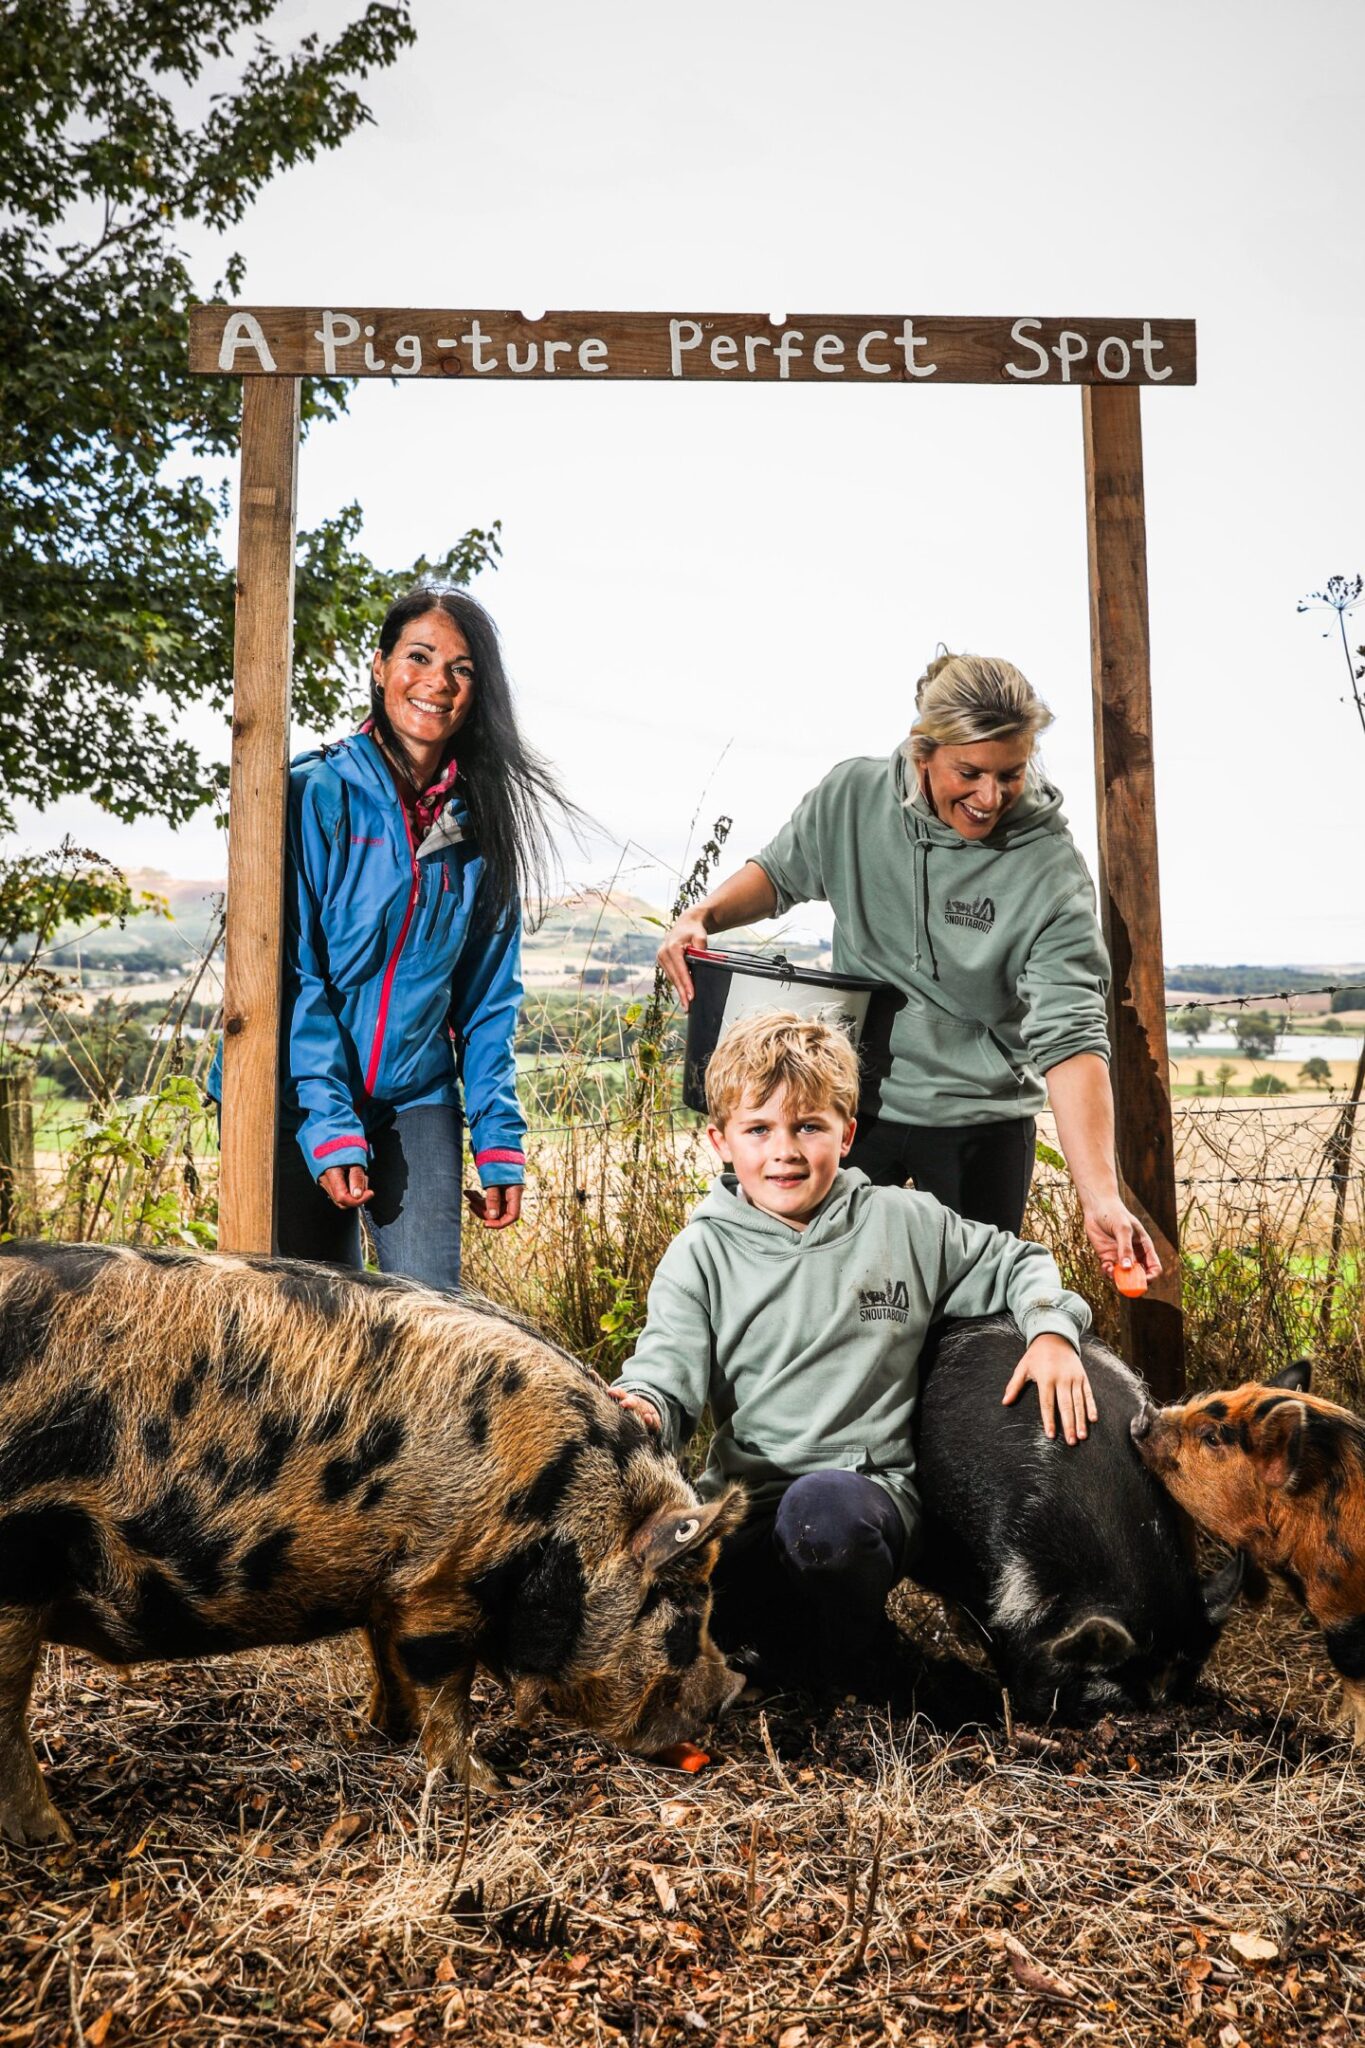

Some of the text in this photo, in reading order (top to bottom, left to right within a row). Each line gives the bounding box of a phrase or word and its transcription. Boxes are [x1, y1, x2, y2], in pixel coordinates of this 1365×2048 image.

[218, 310, 1173, 383] A Pig-ture Perfect Spot
[944, 914, 992, 934] SNOUTABOUT
[860, 1307, 908, 1324] SNOUTABOUT
